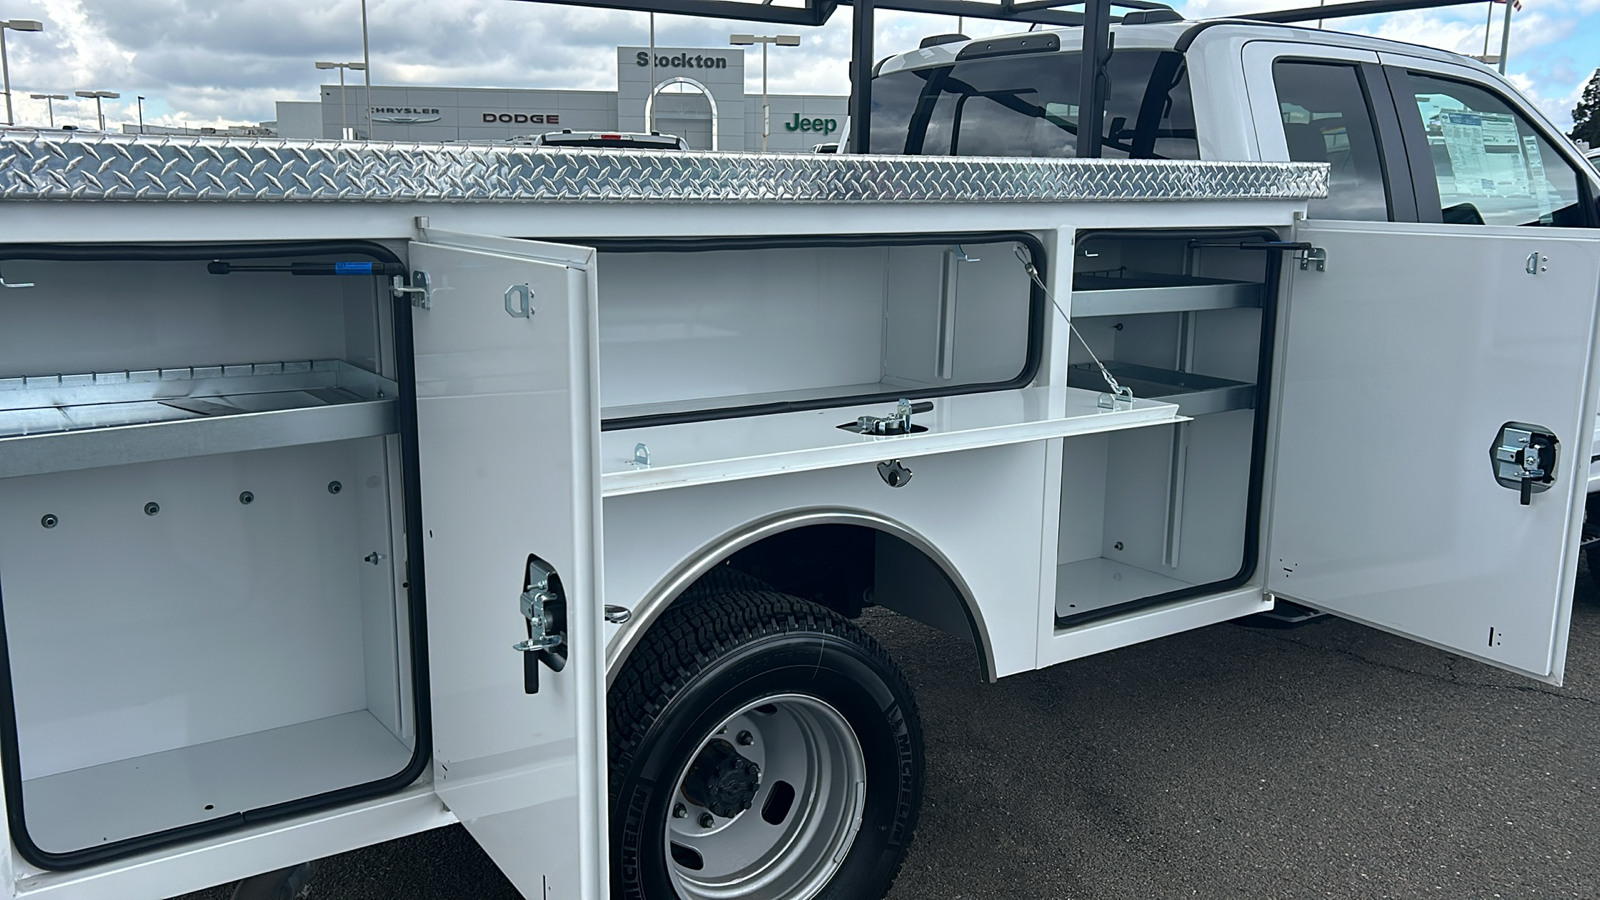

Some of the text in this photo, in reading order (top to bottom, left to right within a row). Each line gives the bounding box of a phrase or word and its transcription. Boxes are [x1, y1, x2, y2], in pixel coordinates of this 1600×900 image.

[636, 51, 727, 69] Stockton
[482, 113, 559, 125] DODGE
[785, 112, 838, 136] Jeep
[892, 733, 912, 842] MICHELIN
